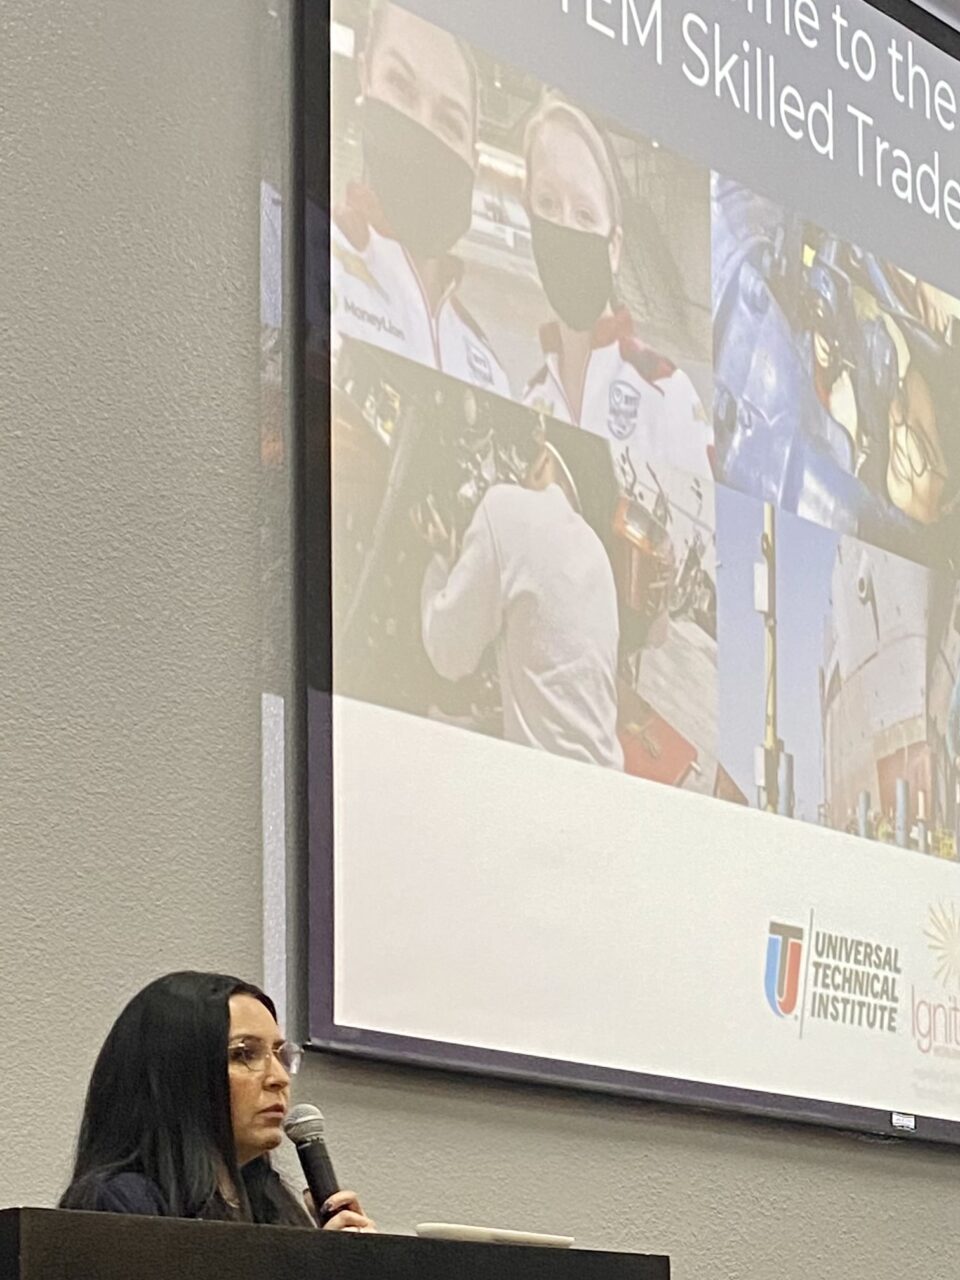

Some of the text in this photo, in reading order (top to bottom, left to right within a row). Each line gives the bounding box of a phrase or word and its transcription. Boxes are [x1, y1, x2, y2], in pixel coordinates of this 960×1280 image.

[562, 0, 662, 66] EM
[682, 12, 834, 161] Skilled
[832, 4, 877, 82] to
[888, 41, 957, 132] the
[814, 931, 901, 974] UNIVERSAL
[812, 961, 899, 1004] TECHNICAL
[811, 991, 898, 1033] INSTITUTE
